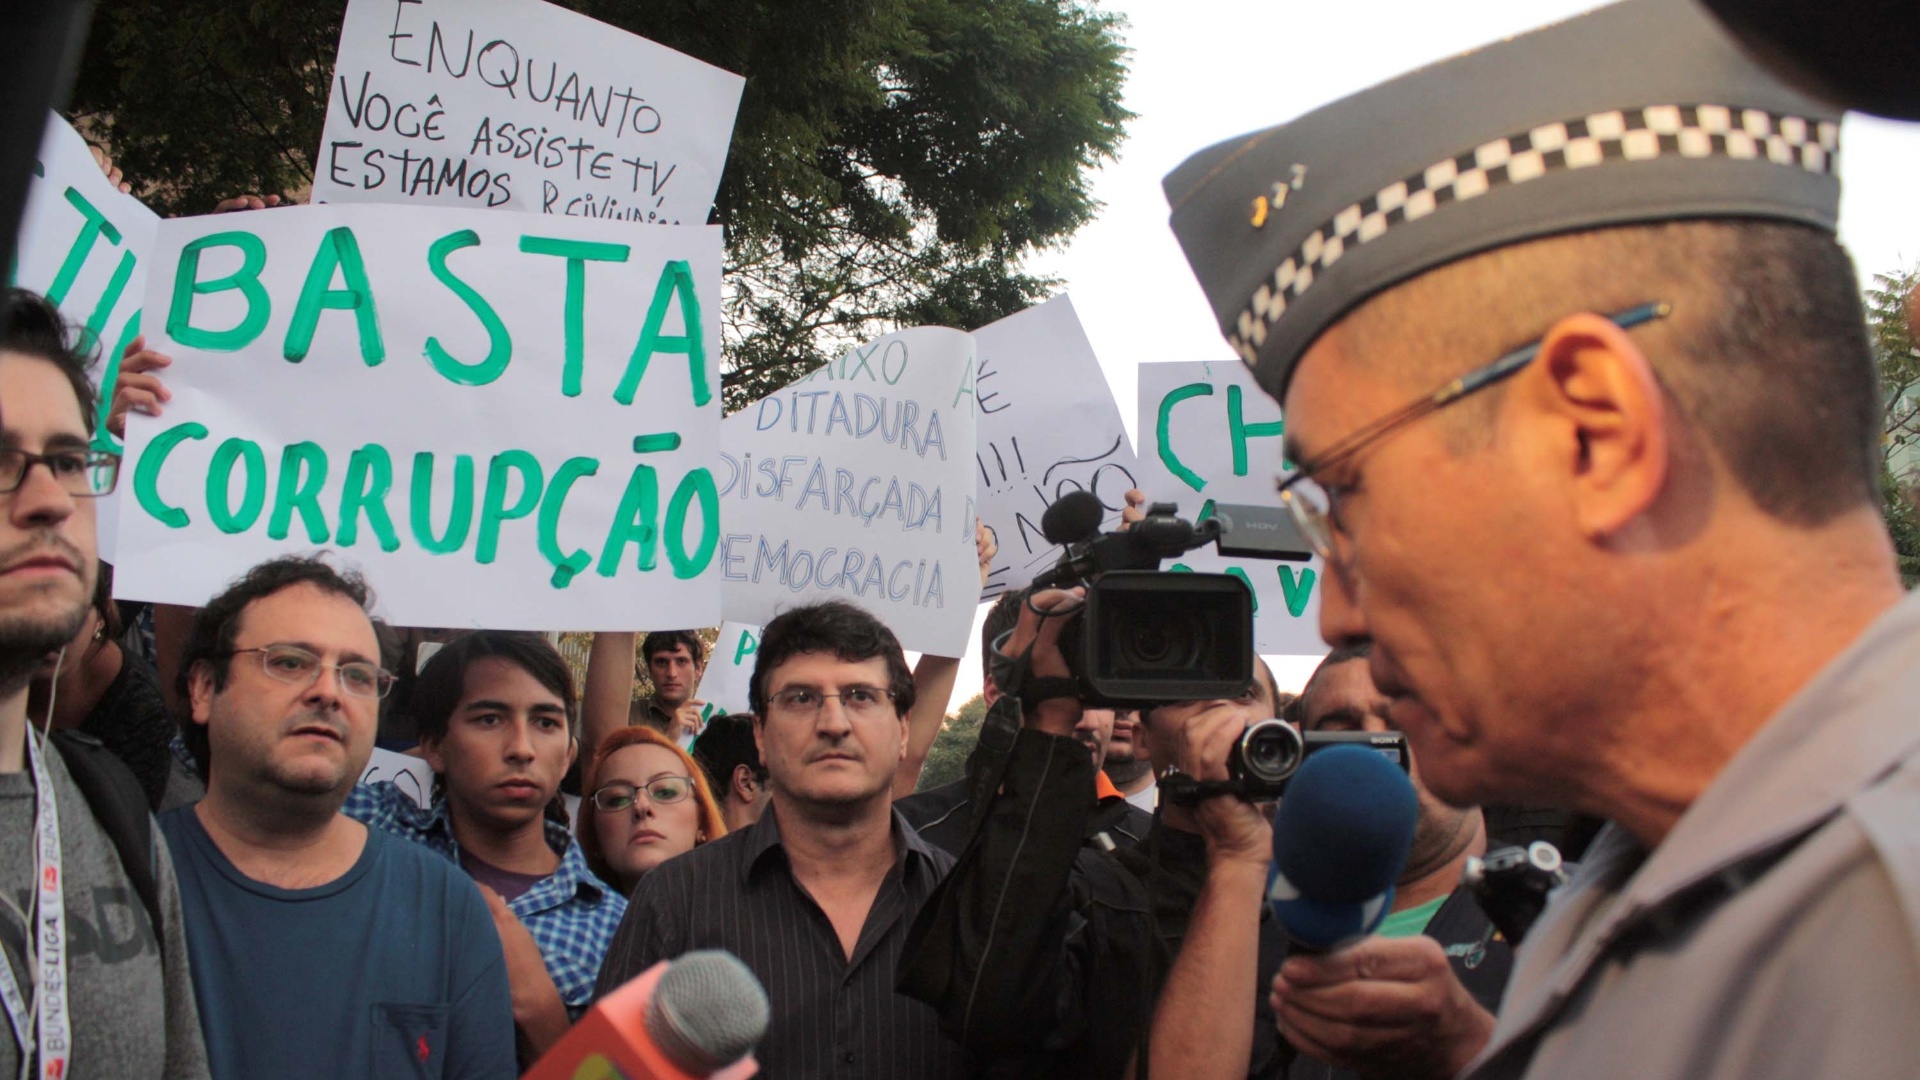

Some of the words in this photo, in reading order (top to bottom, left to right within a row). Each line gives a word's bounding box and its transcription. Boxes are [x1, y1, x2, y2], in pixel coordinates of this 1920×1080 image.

[340, 71, 446, 141] VOCÊ
[388, 0, 661, 138] ENQUANTO
[330, 141, 511, 208] ESTAMOS
[165, 225, 712, 408] BASTA
[132, 421, 721, 590] CORRUPÇÃO
[720, 533, 944, 609] EMOCRACIA
[44, 917, 66, 1051] BUNDESLIGA
